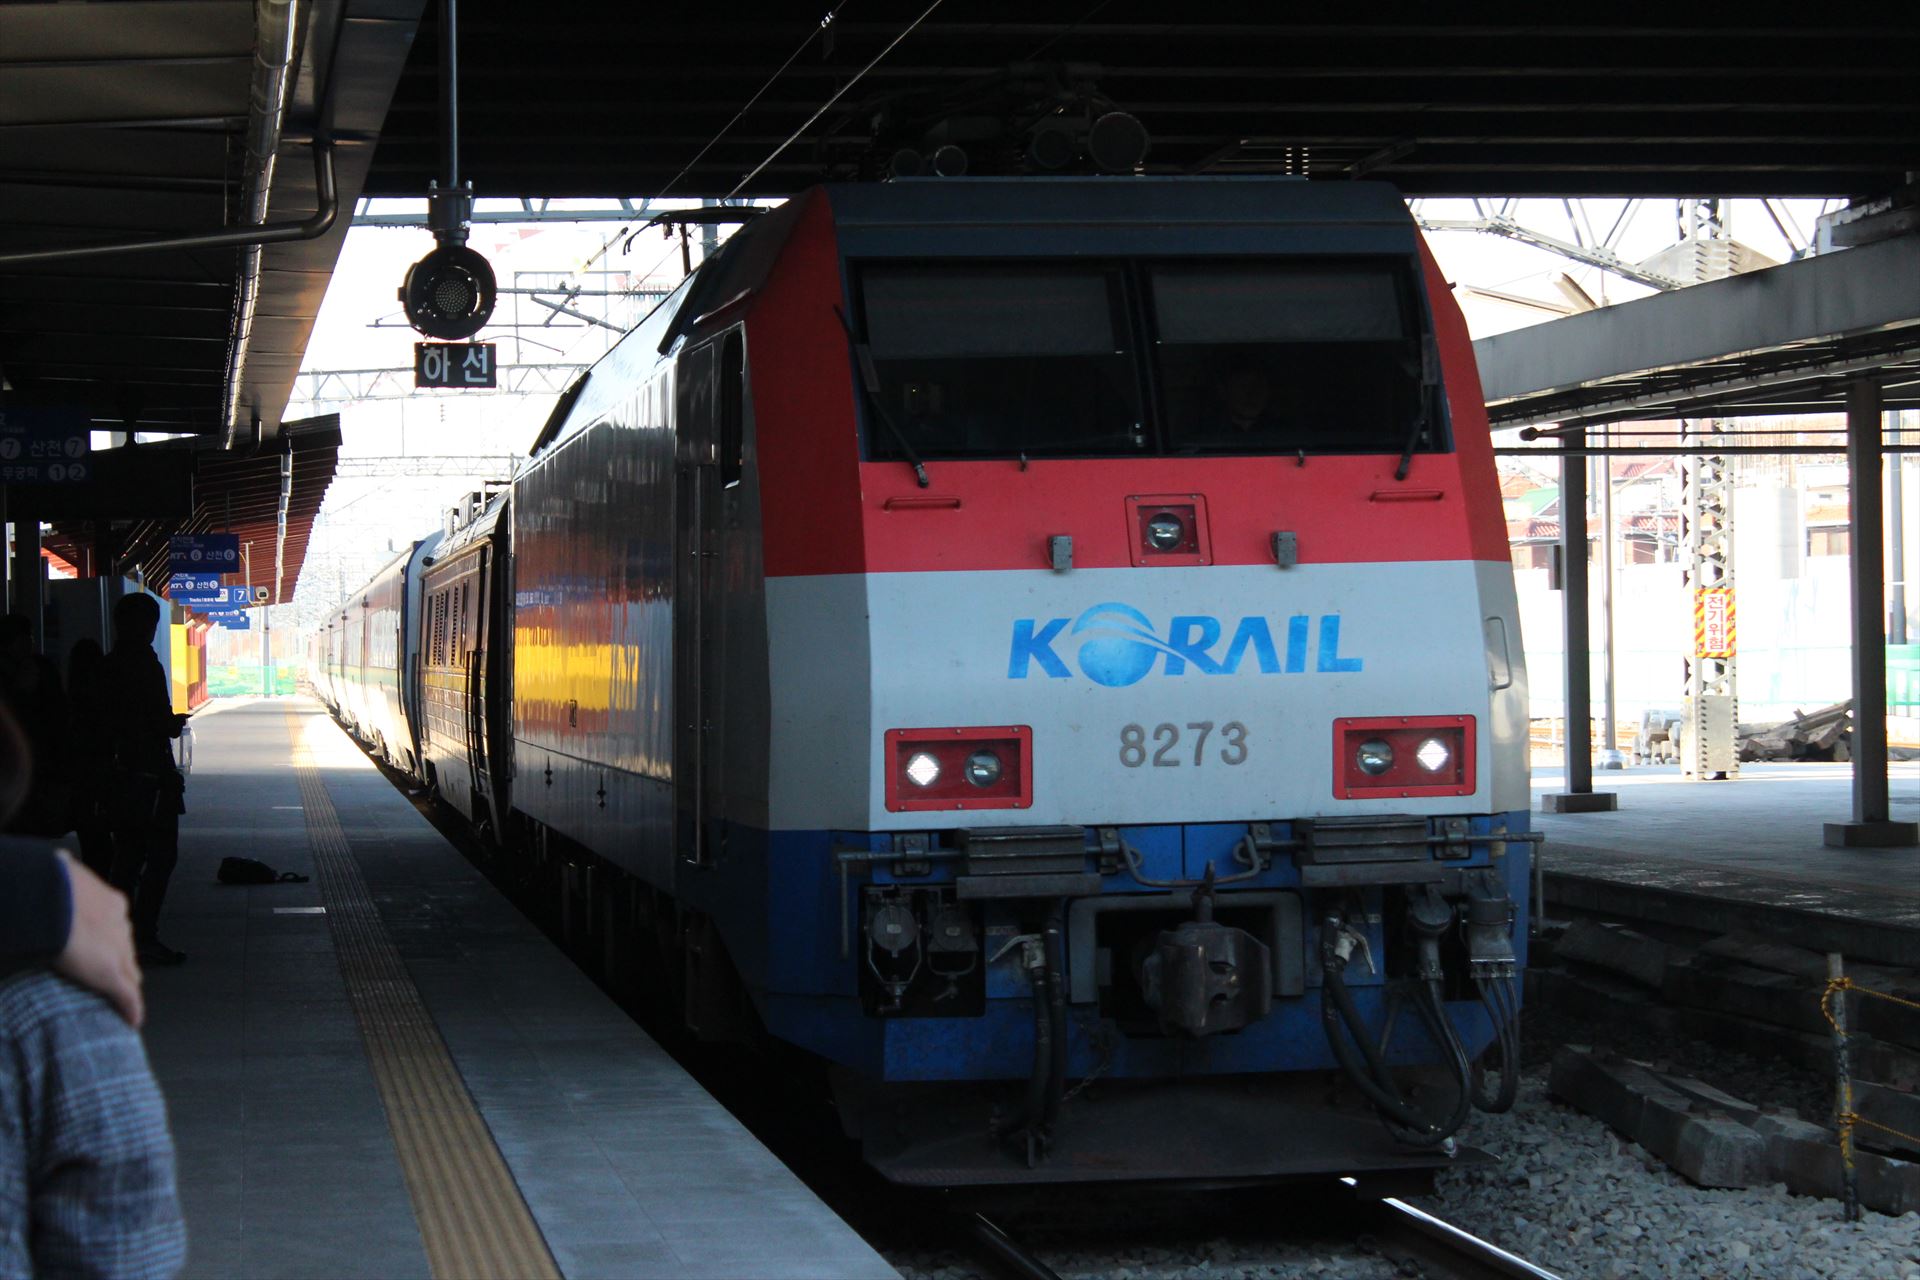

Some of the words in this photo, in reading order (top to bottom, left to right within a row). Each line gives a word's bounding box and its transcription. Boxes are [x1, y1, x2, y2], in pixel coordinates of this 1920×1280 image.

[31, 440, 62, 458] 산천
[237, 590, 245, 600] 7
[1007, 601, 1364, 688] KORAIL
[1119, 721, 1249, 769] 8273
